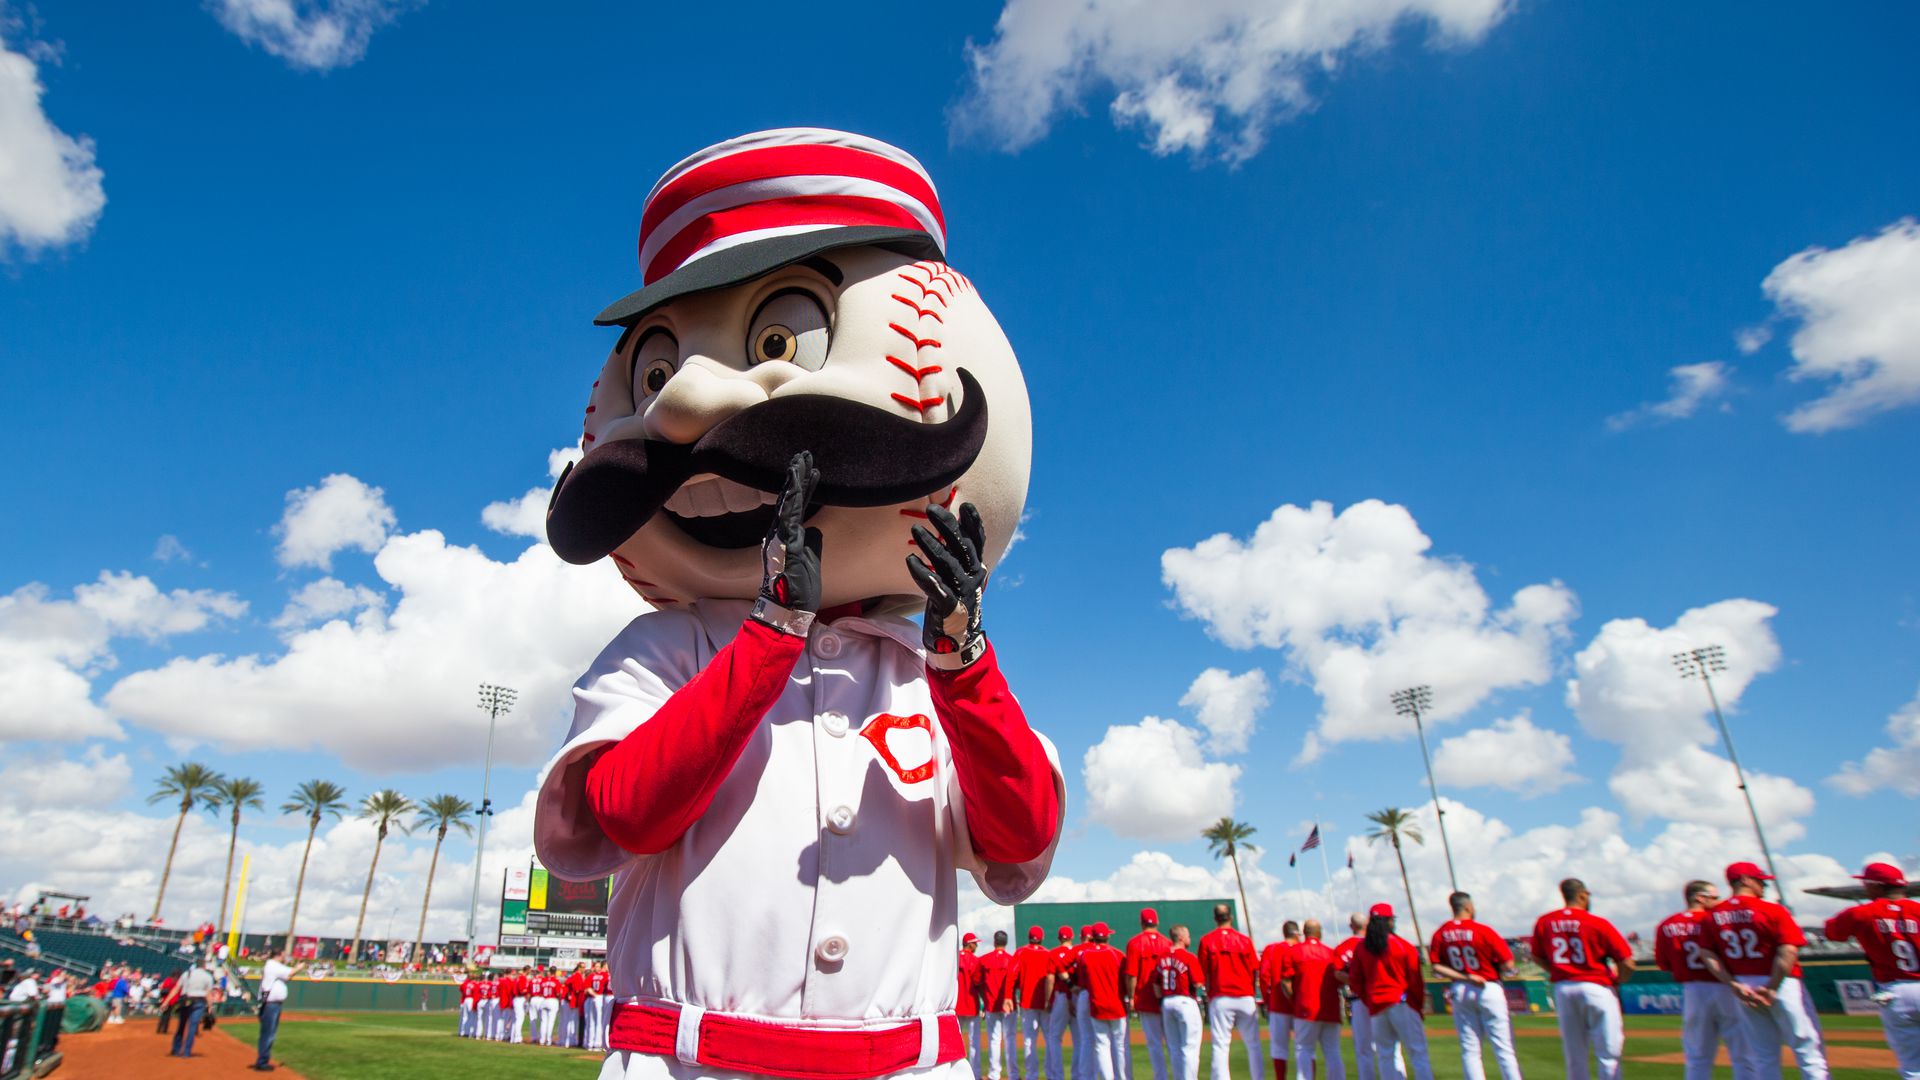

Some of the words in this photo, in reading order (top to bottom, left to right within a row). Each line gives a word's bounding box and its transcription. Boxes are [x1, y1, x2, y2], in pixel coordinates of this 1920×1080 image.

[1551, 920, 1581, 934] LUTZ
[1552, 937, 1586, 965] 23
[1720, 928, 1764, 959] 32
[1447, 945, 1480, 971] 66
